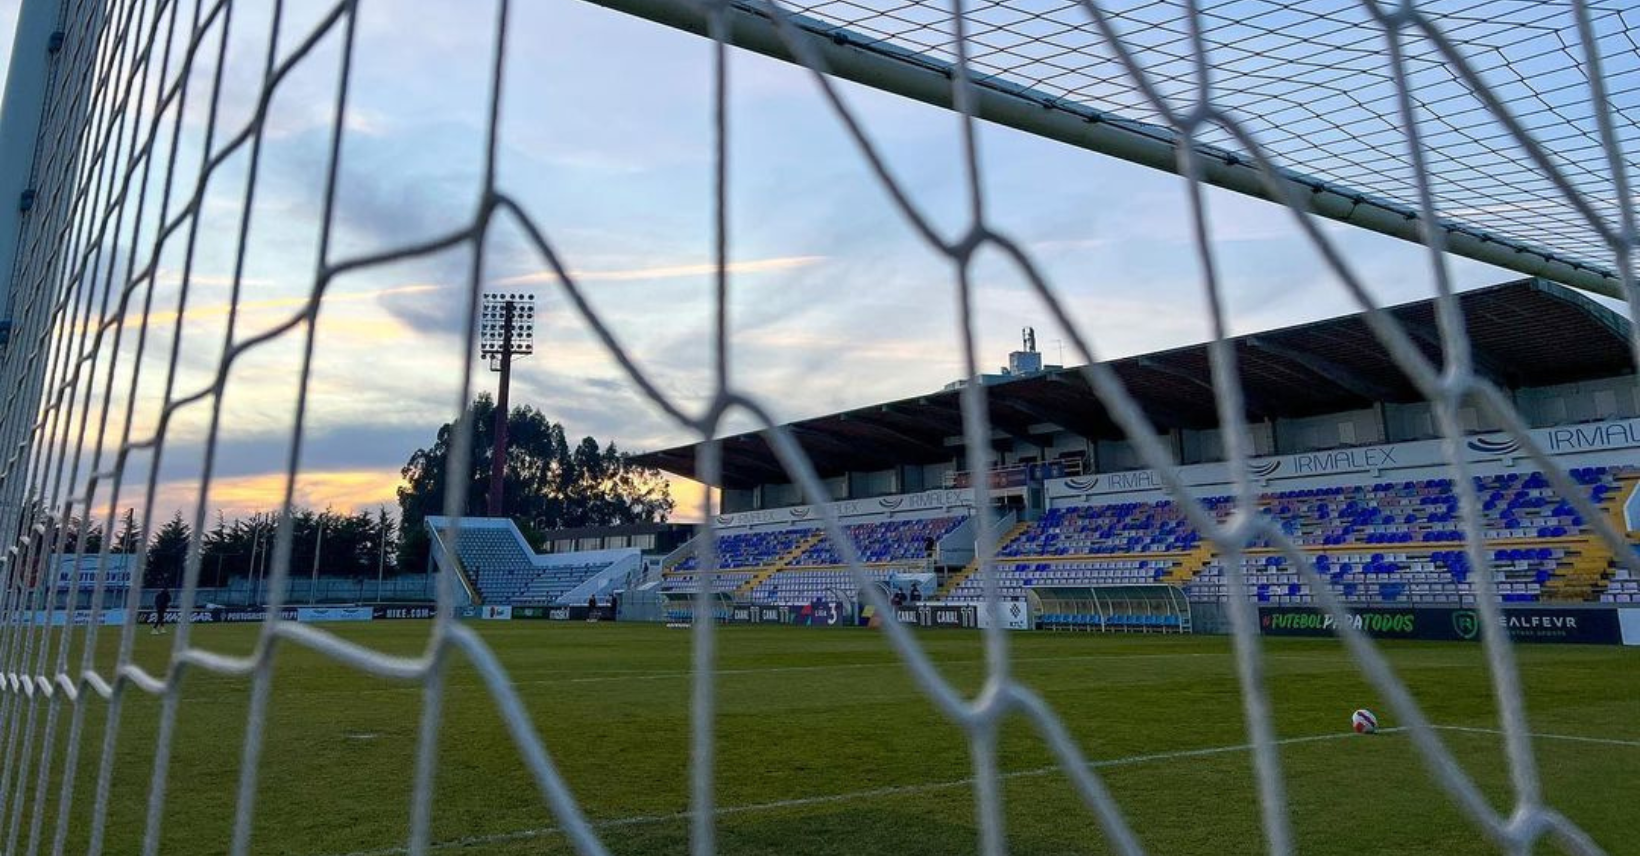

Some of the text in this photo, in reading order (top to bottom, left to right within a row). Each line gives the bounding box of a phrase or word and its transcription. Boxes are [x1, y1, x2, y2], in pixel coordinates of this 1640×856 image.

[1293, 446, 1397, 474] IRMALEX
[1107, 468, 1186, 490] IRMAL
[386, 609, 429, 618] NIKE.COM
[734, 609, 750, 620] CANAL
[763, 609, 778, 620] CANAL
[827, 602, 838, 625] 3
[897, 610, 918, 623] CANAL
[936, 610, 959, 623] CANAL
[1489, 615, 1577, 629] EALFEVR
[1262, 612, 1415, 633] #FUTEBOLPATODOS
